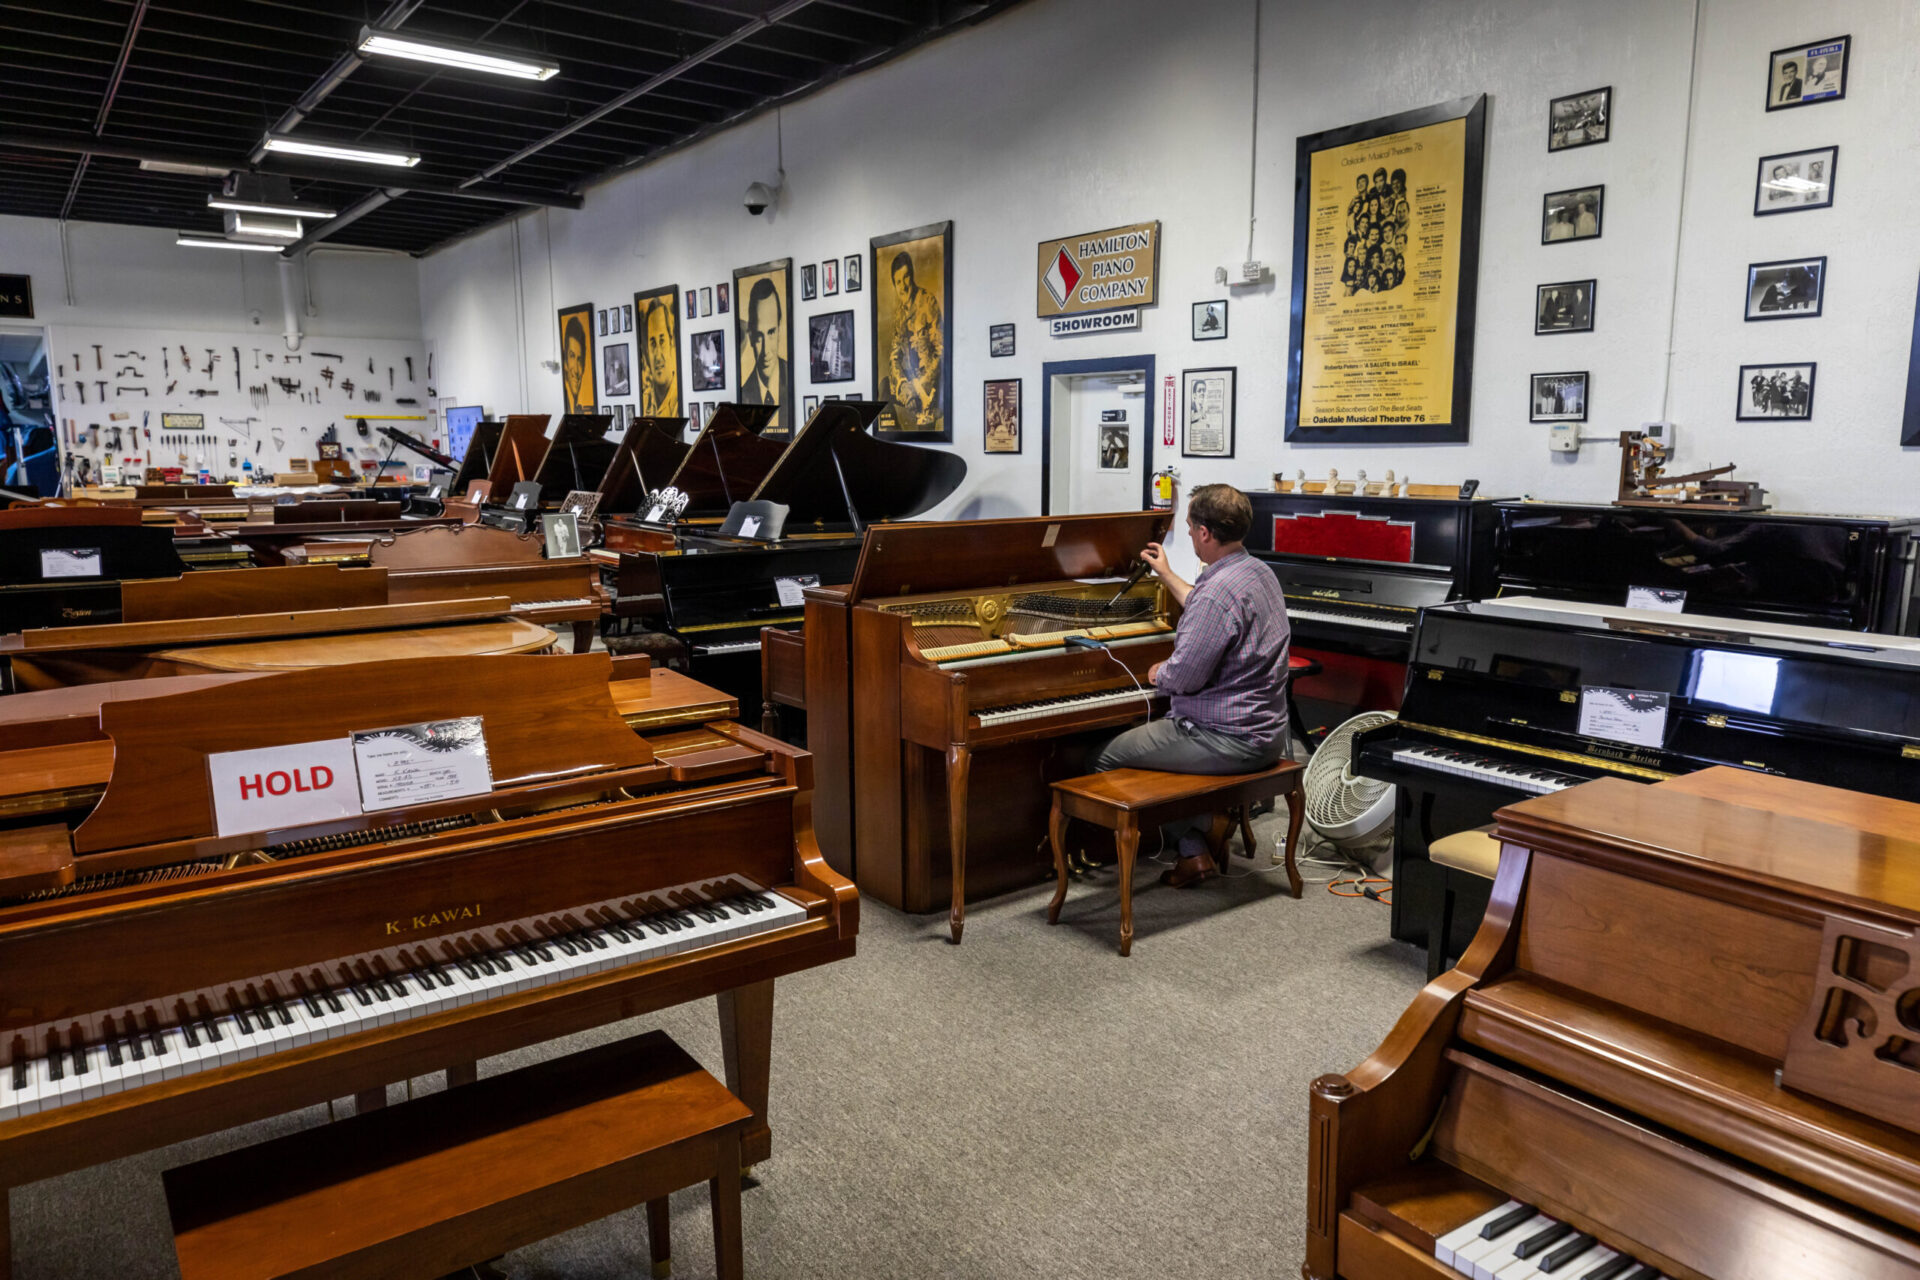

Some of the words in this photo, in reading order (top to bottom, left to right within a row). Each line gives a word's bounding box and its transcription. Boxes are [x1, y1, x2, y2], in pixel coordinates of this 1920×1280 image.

[1079, 231, 1149, 258] HAMILTON
[1092, 258, 1135, 279] PIANO
[1079, 278, 1149, 302] COMPANY
[1053, 313, 1135, 333] SHOWROOM
[1313, 415, 1344, 424] Oakdale
[1346, 415, 1378, 423] Musical
[1379, 414, 1411, 423] Theatre
[1413, 414, 1425, 422] 76
[1391, 404, 1405, 412] Best
[1406, 404, 1422, 412] Seats
[239, 765, 334, 800] HOLD
[385, 920, 407, 935] K.
[412, 904, 481, 929] KAWAI
